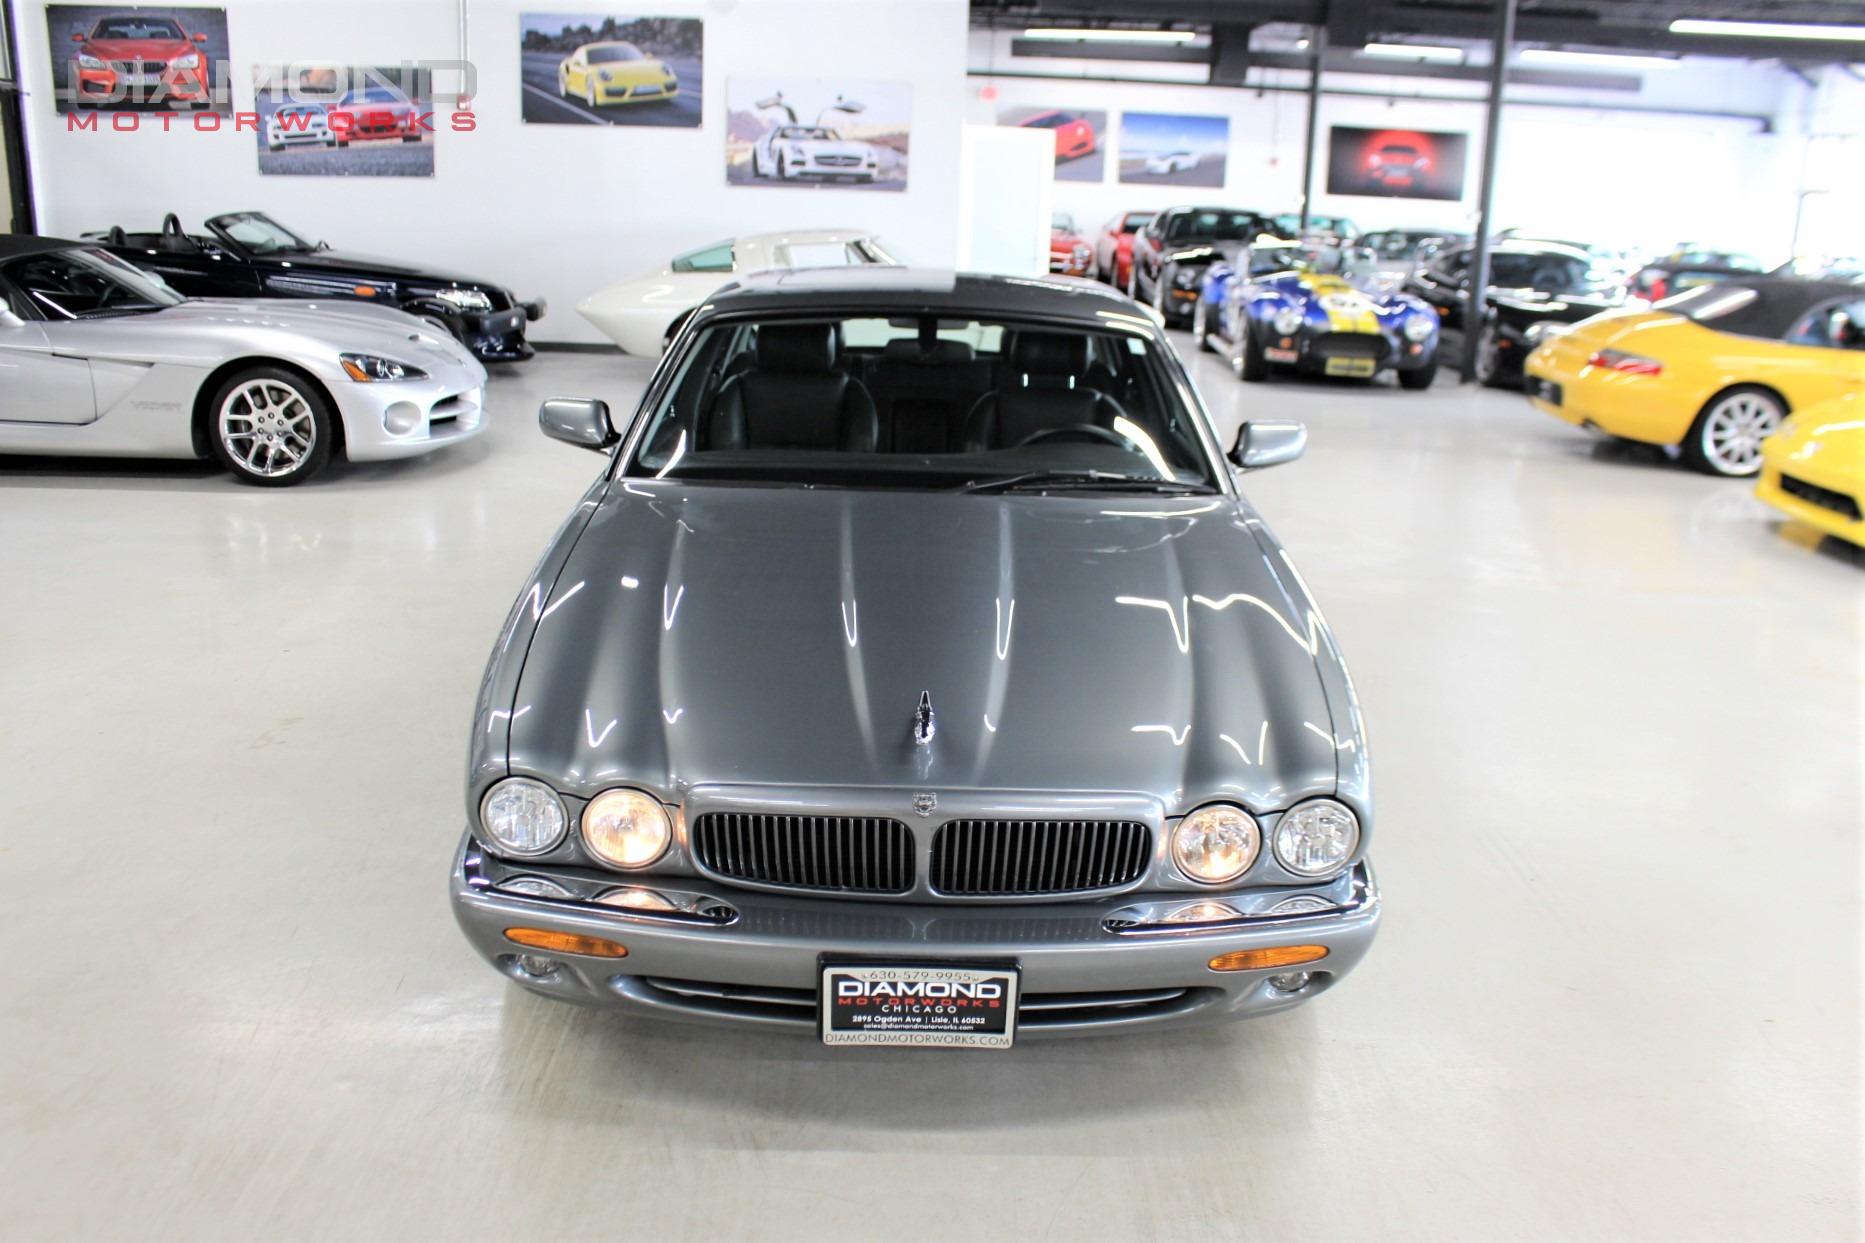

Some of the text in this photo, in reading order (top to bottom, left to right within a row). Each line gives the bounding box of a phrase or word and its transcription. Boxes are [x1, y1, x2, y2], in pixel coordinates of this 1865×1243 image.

[870, 970, 972, 982] 630-579-9955
[837, 981, 1001, 998] DIAMOND
[837, 998, 1000, 1008] MOTORWORKS
[881, 1004, 957, 1014] CHICAGO
[852, 1015, 872, 1023] 2895
[873, 1015, 903, 1025] Ogden
[904, 1015, 922, 1023] Ave
[952, 1016, 960, 1024] IL
[961, 1016, 986, 1025] 60532
[863, 1023, 974, 1031] sales@diamondmotorworks.com
[825, 1033, 1010, 1046] DIAMONDMOTORWORKS.COM
